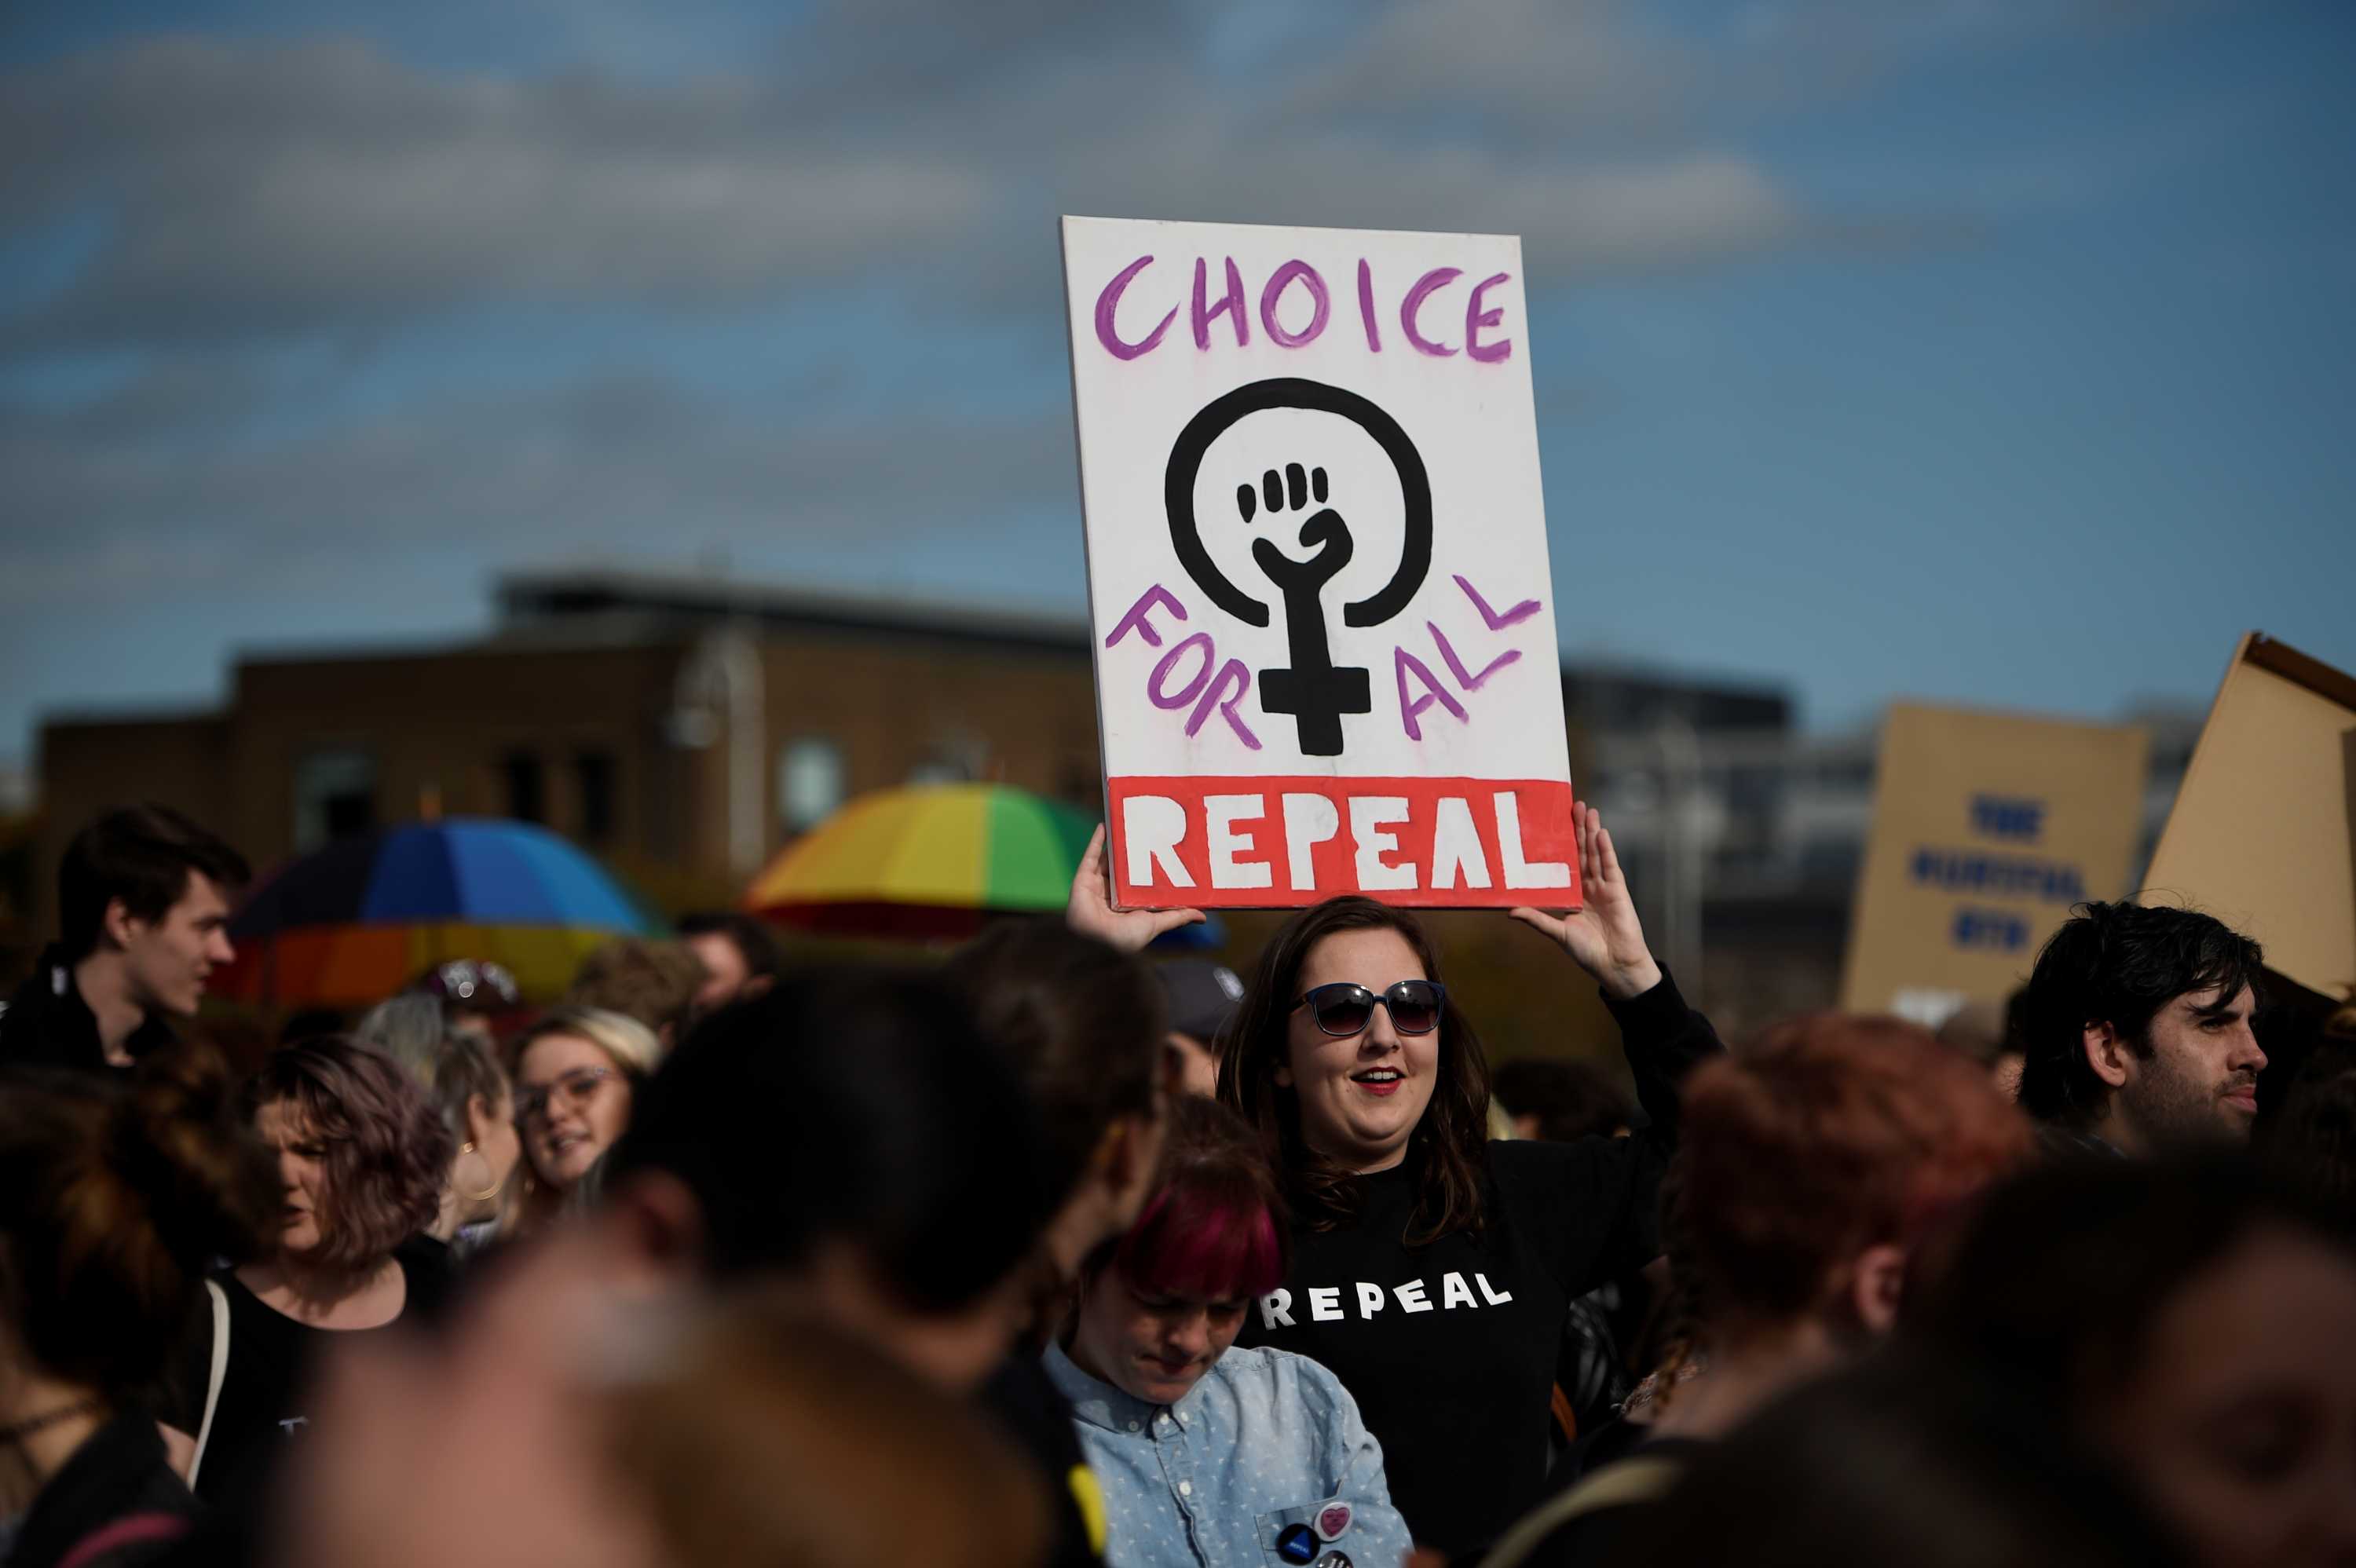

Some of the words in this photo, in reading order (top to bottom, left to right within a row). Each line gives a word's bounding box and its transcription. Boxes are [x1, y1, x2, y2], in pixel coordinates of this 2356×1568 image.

[1095, 254, 1511, 364] CHOICE
[1105, 583, 1262, 751] FOR
[1394, 574, 1542, 741] ALL
[1121, 791, 1571, 892] REPEAL
[1258, 1270, 1513, 1331] REPEAL
